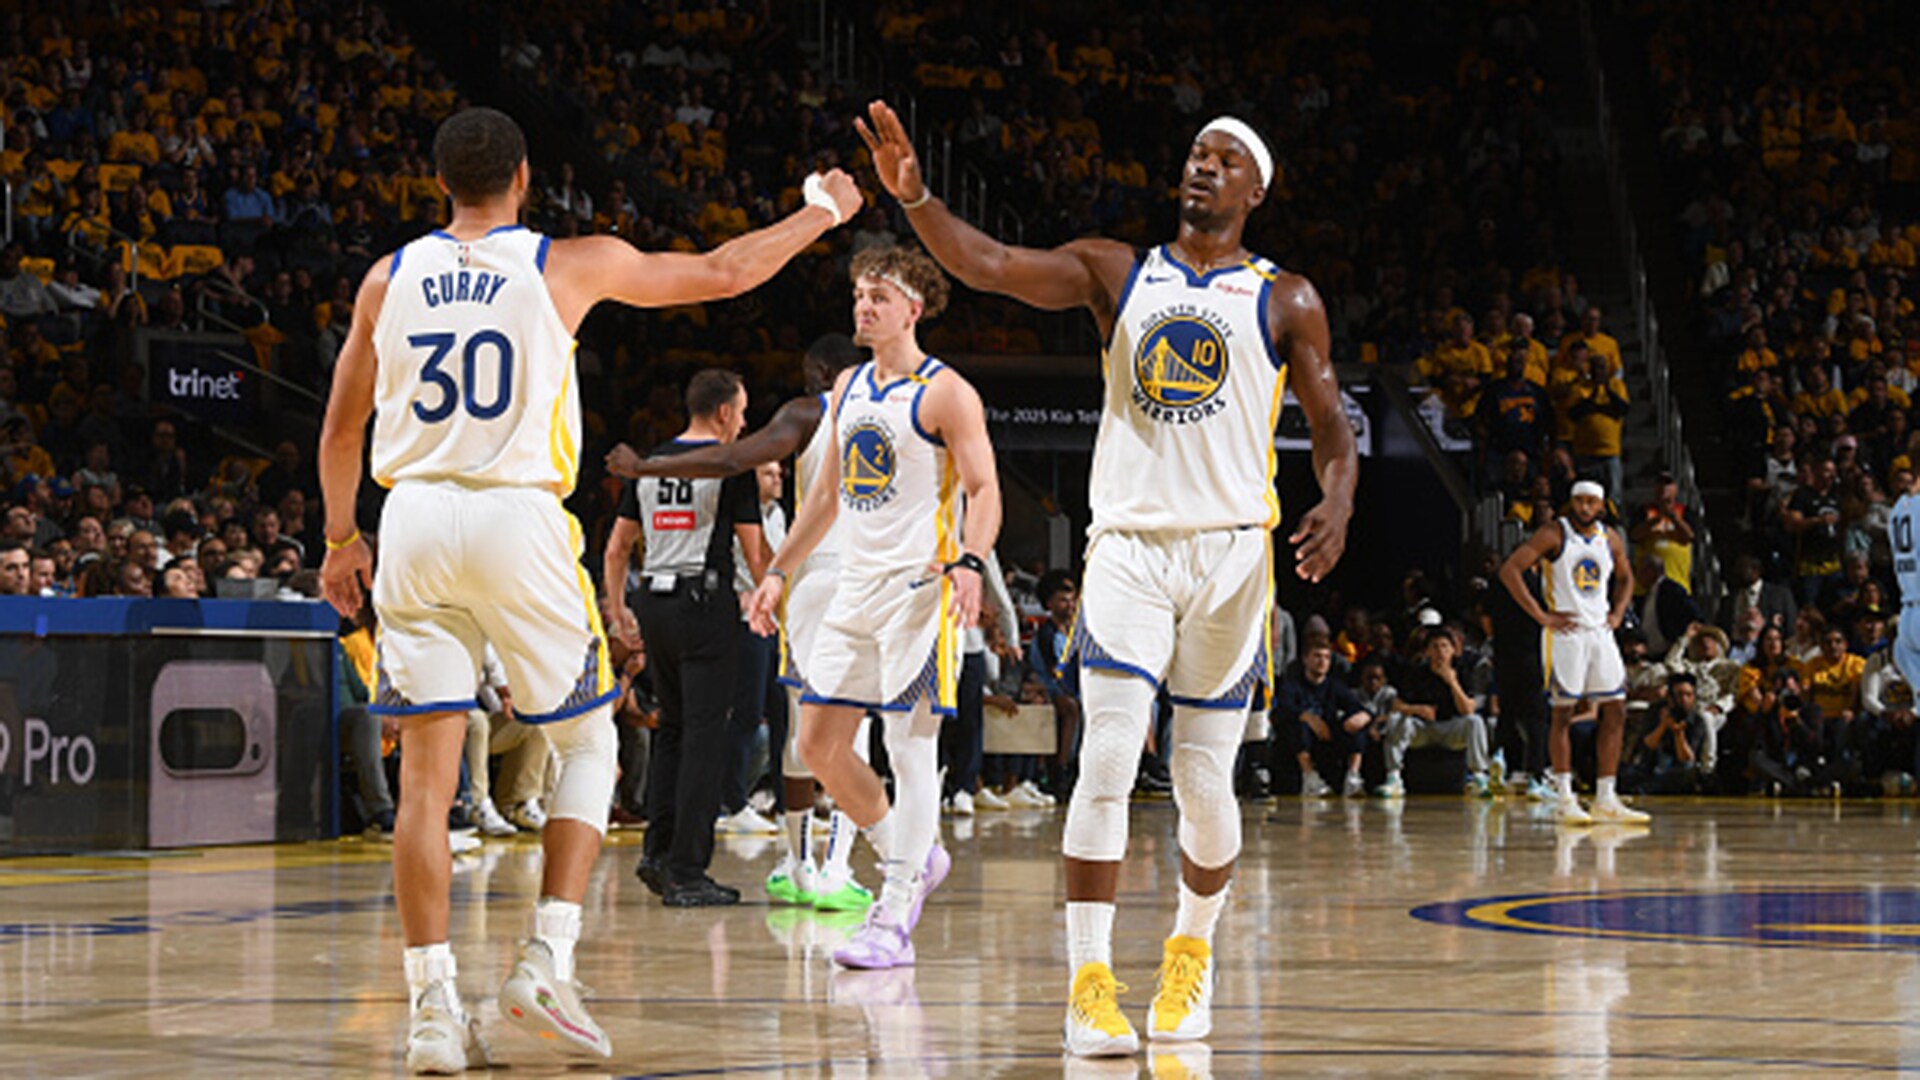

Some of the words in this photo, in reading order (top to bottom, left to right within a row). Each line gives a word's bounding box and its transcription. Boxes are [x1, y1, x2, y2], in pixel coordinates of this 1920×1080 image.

[421, 270, 507, 307] CURRY
[1192, 339, 1217, 367] 10
[169, 367, 240, 399] trinet
[407, 329, 514, 424] 30
[1131, 386, 1226, 424] WARRIORS
[24, 718, 96, 786] Pro
